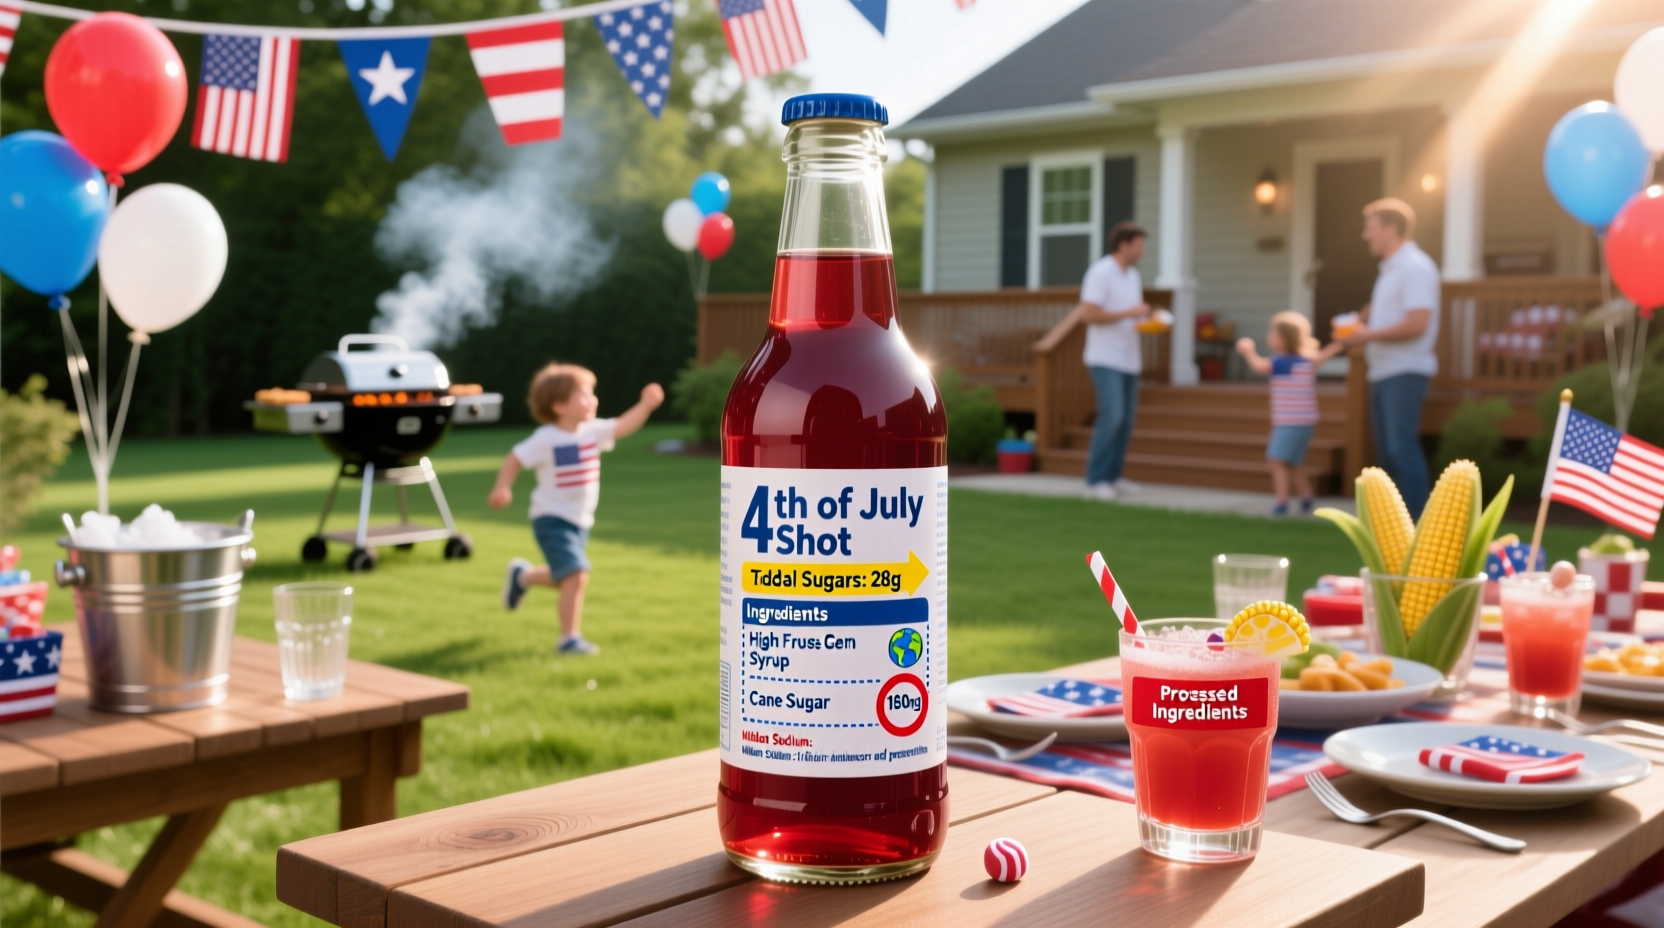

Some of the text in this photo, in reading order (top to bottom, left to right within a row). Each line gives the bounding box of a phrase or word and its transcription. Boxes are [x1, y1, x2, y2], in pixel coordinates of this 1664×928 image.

[741, 485, 924, 553] 4th of July
[776, 524, 852, 556] Shot
[802, 570, 867, 593] Sugars:
[871, 570, 902, 592] 28g
[749, 631, 779, 651] High
[749, 651, 790, 672] Syrup
[749, 690, 831, 713] Cane Sugar
[1152, 702, 1248, 724] Ingredients
